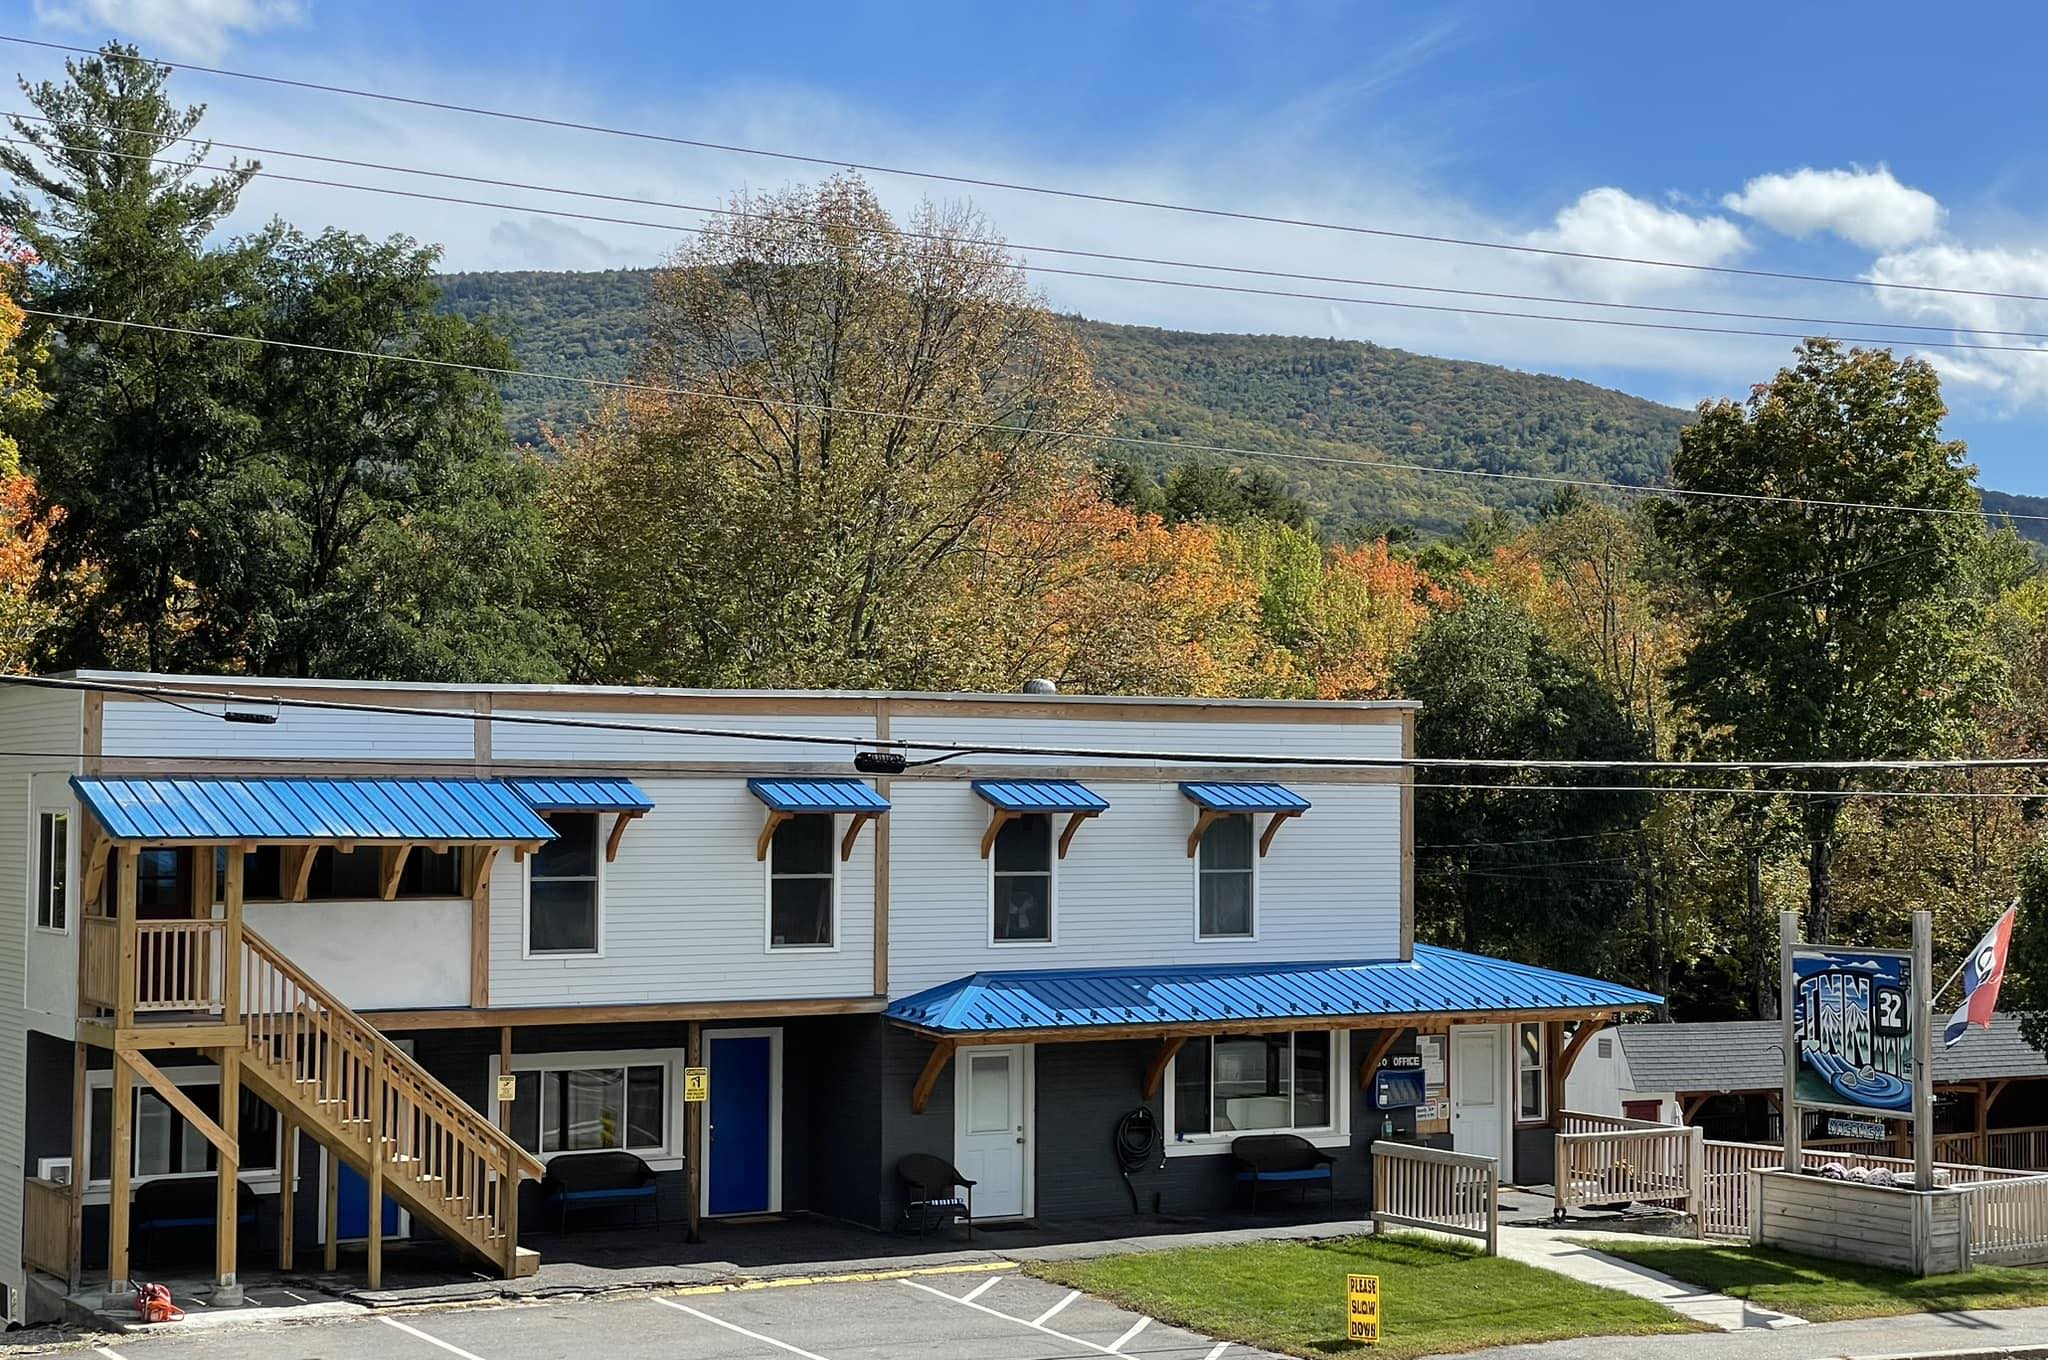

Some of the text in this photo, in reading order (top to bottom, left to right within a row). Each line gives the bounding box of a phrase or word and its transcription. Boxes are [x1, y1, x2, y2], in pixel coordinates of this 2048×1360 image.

[1879, 991, 1903, 1029] 32
[1800, 973, 1871, 1067] INN
[1393, 1056, 1421, 1067] OFFICE
[1350, 1278, 1376, 1294] PLEASE
[1351, 1299, 1376, 1315] SLOW
[1351, 1321, 1376, 1337] DOWN
